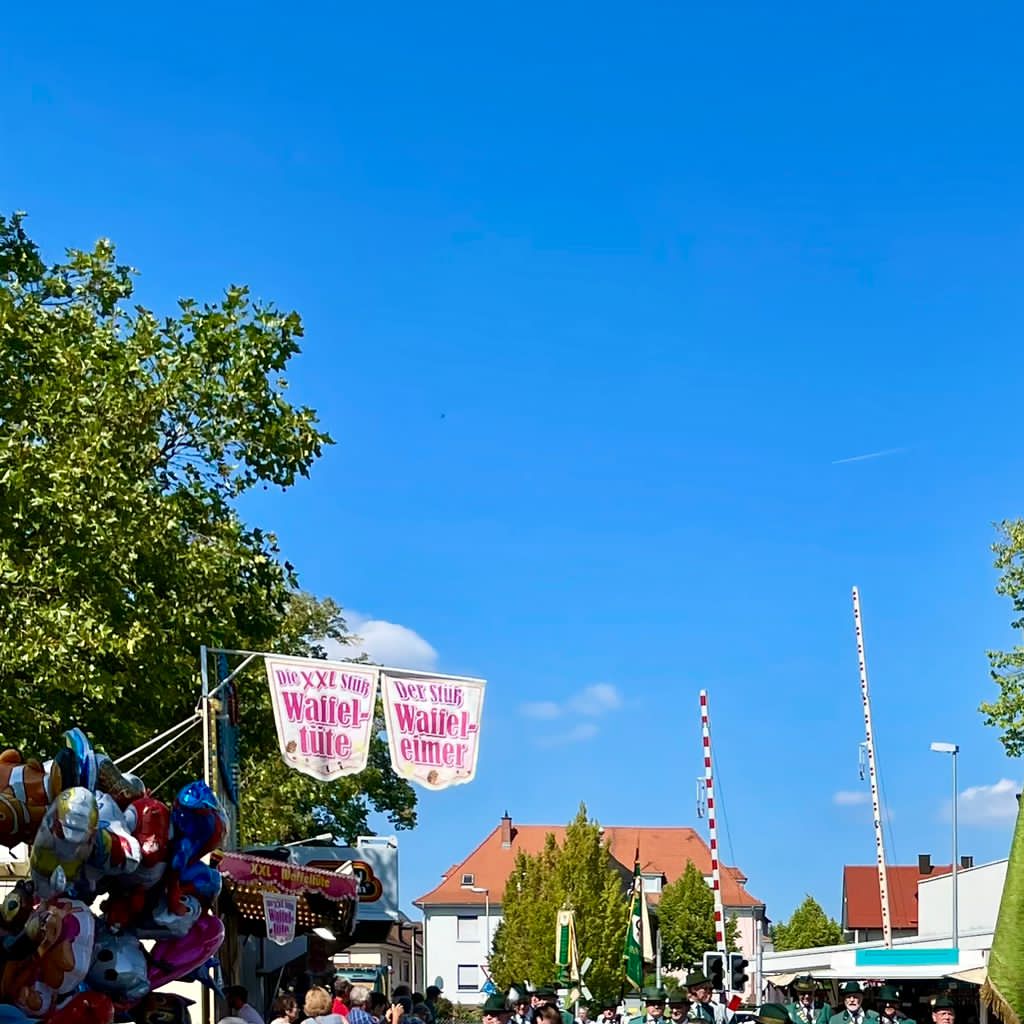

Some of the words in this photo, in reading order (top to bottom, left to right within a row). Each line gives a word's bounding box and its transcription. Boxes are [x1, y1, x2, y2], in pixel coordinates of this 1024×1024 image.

[275, 669, 298, 687] Die
[301, 670, 337, 690] XXL
[393, 681, 425, 701] Der
[282, 691, 370, 728] Waffel-
[394, 703, 478, 740] Waffel-
[299, 725, 352, 759] tüte
[400, 736, 468, 768] eimer
[250, 863, 271, 877] XXL
